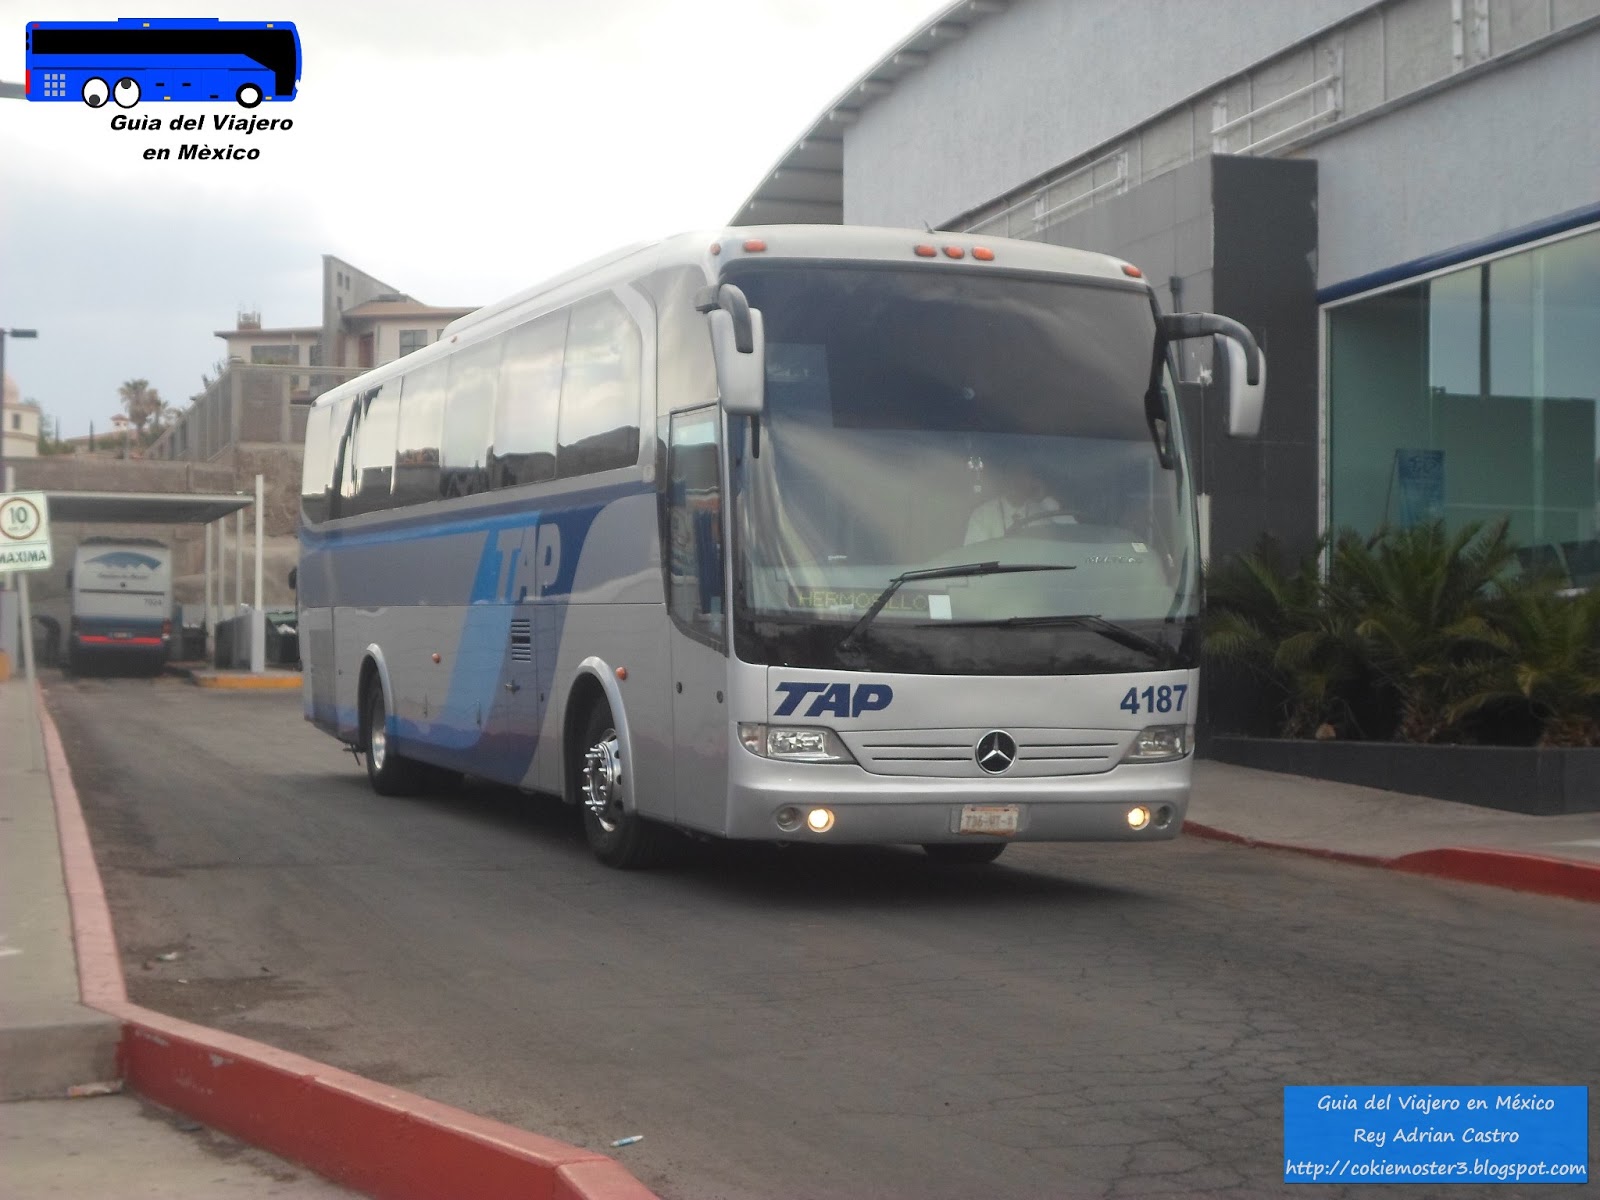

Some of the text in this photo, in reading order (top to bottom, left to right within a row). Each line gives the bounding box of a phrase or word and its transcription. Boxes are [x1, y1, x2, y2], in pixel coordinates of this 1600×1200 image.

[9, 506, 28, 524] 10
[495, 522, 562, 603] TAP
[798, 591, 929, 611] HERMOLLO
[773, 682, 893, 718] TAP
[1120, 684, 1188, 714] 4187
